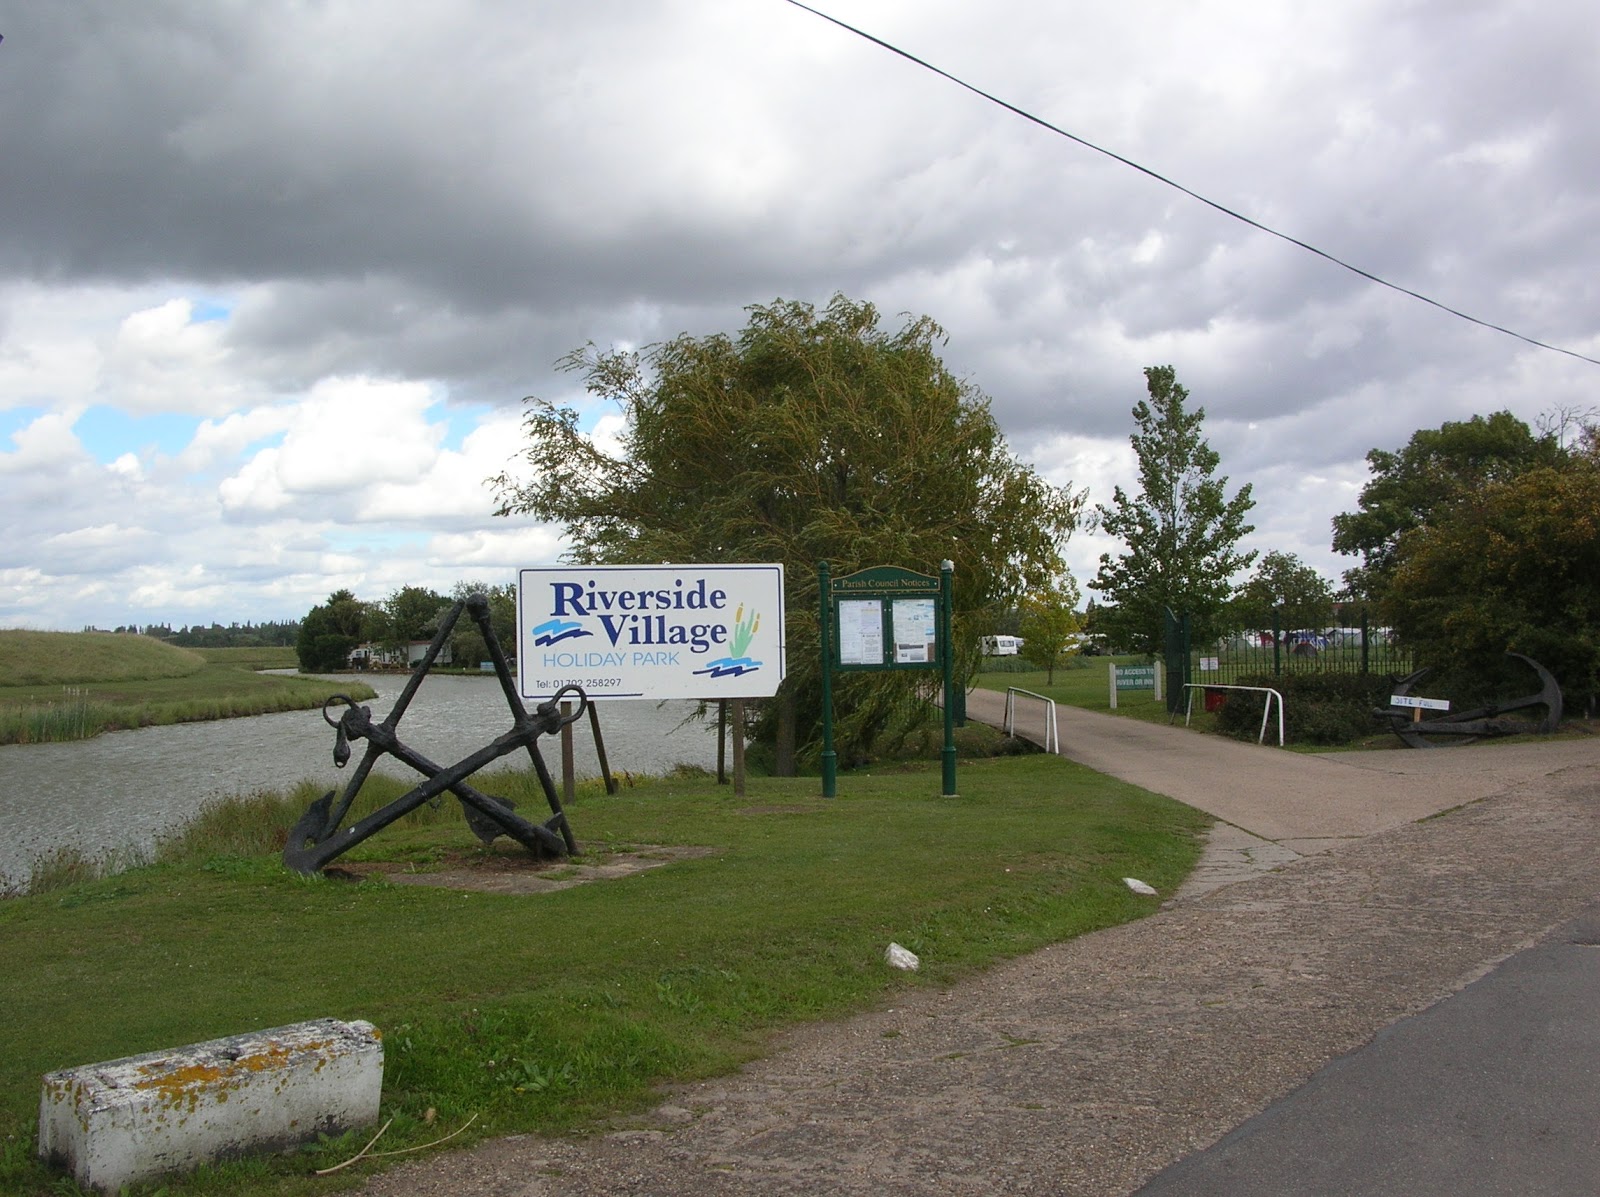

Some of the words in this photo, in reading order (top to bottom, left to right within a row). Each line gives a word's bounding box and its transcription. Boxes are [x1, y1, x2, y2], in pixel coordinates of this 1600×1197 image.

[842, 580, 866, 588] Parish
[868, 579, 899, 588] Council
[901, 578, 930, 587] Notices
[550, 578, 727, 617] Riverside
[597, 614, 727, 654] Village
[543, 652, 627, 667] HOLIDAY
[633, 651, 680, 666] PARK
[536, 680, 551, 689] Tel:
[586, 678, 622, 688] 258297
